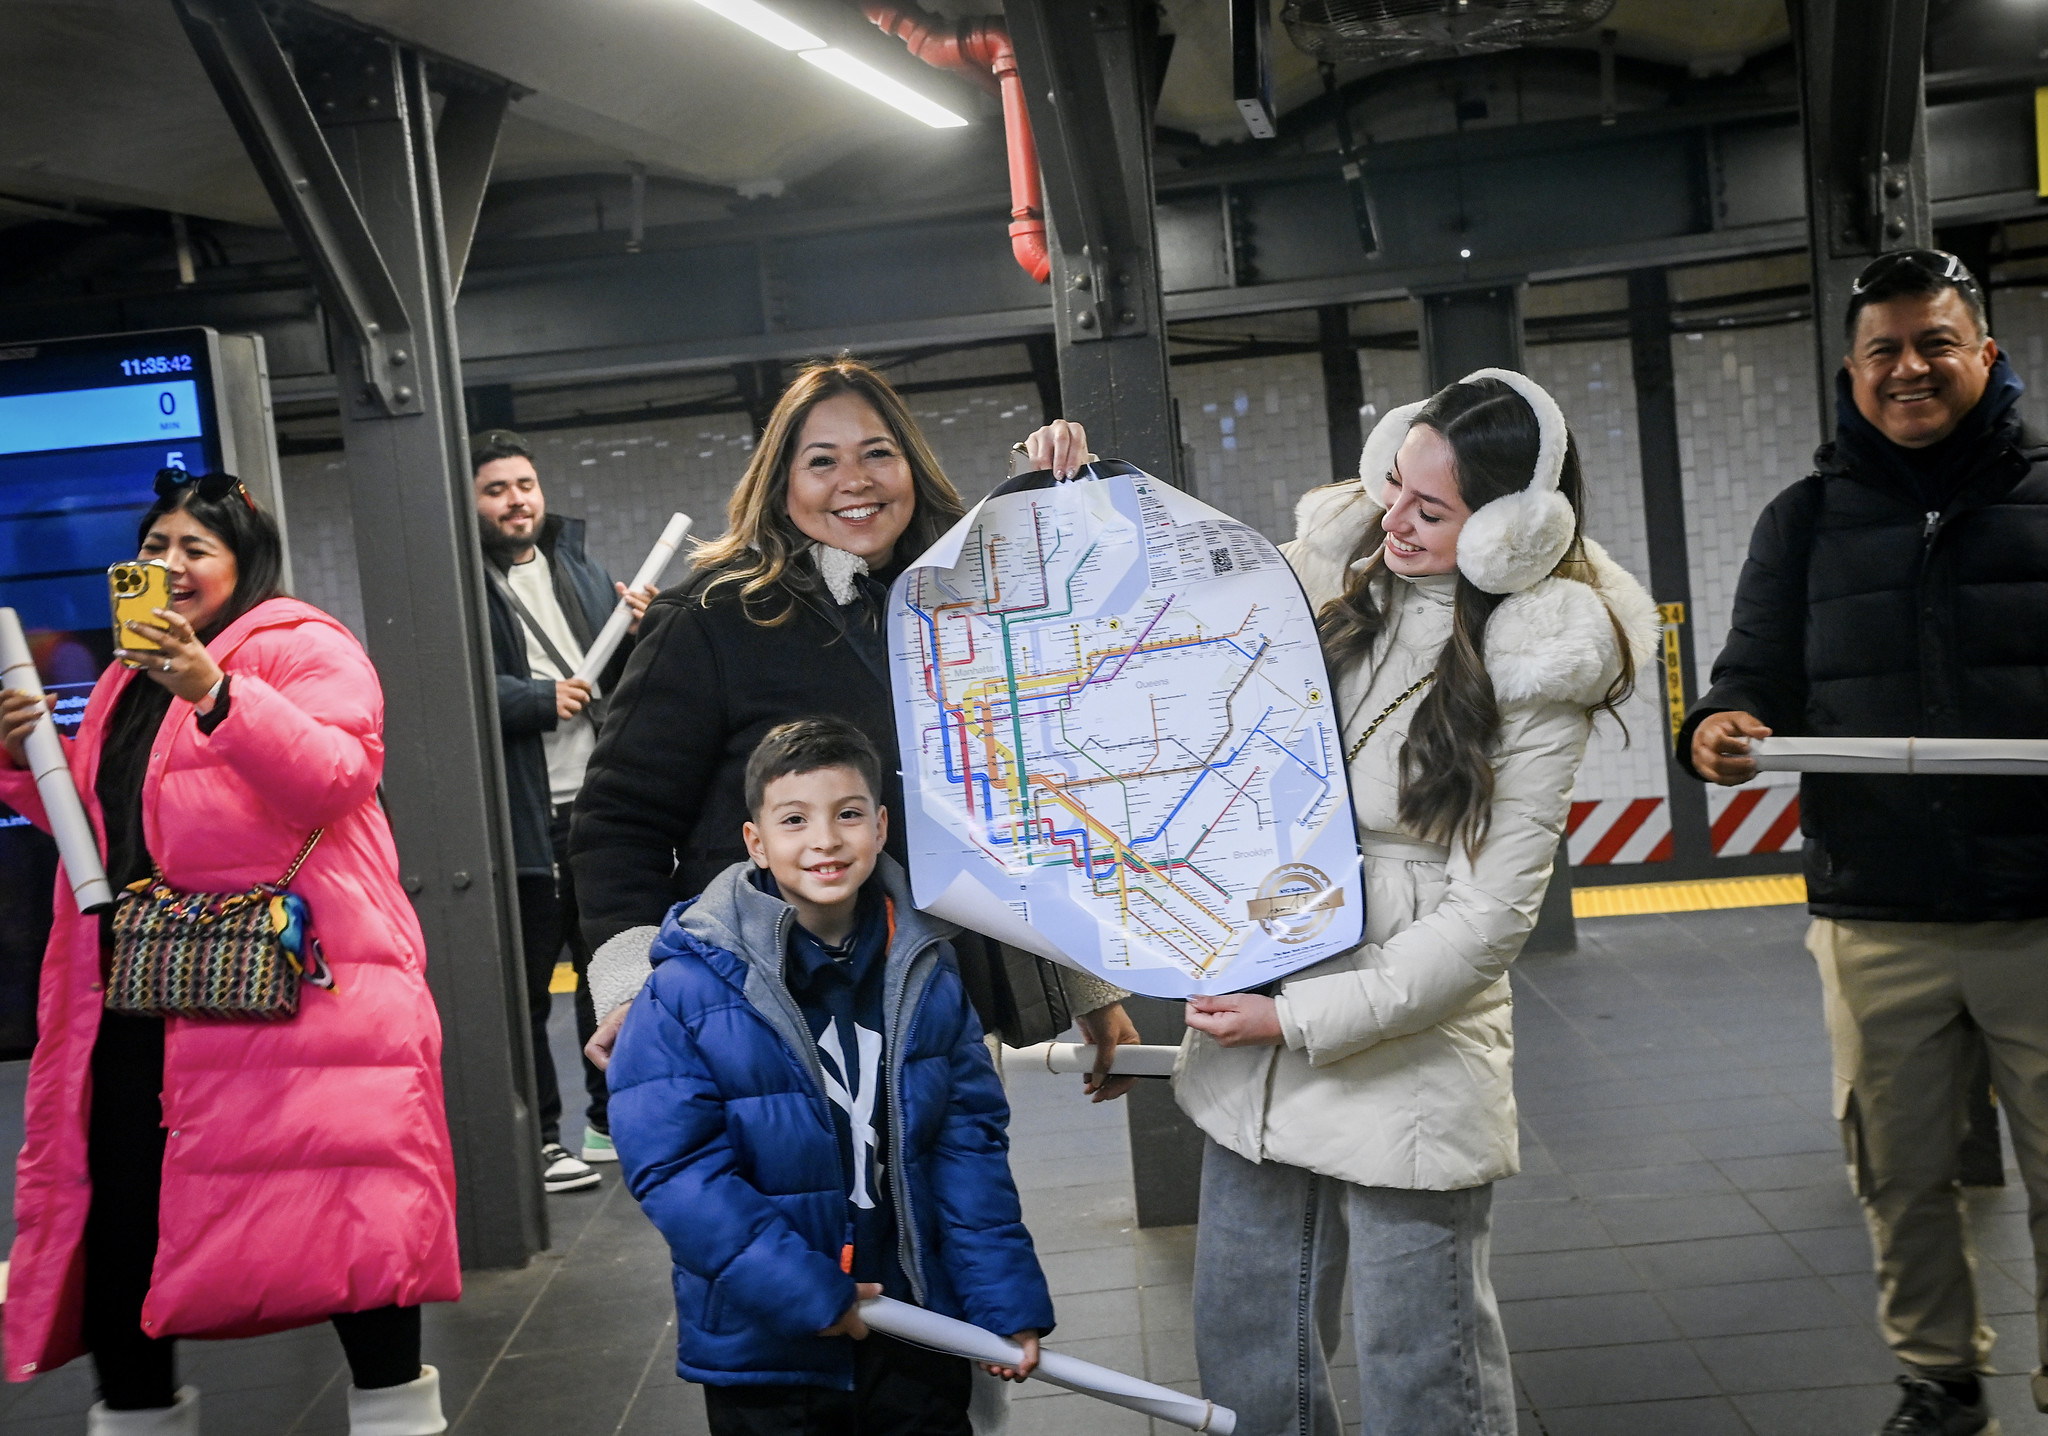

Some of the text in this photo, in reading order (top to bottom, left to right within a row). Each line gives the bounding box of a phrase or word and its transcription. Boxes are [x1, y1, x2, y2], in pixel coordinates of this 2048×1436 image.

[121, 355, 192, 376] 11:35:42
[160, 392, 175, 416] 0
[160, 421, 180, 431] MIN
[954, 665, 1000, 677] Manhattan
[1135, 679, 1169, 689] Queens
[1233, 848, 1274, 860] Brooklyn
